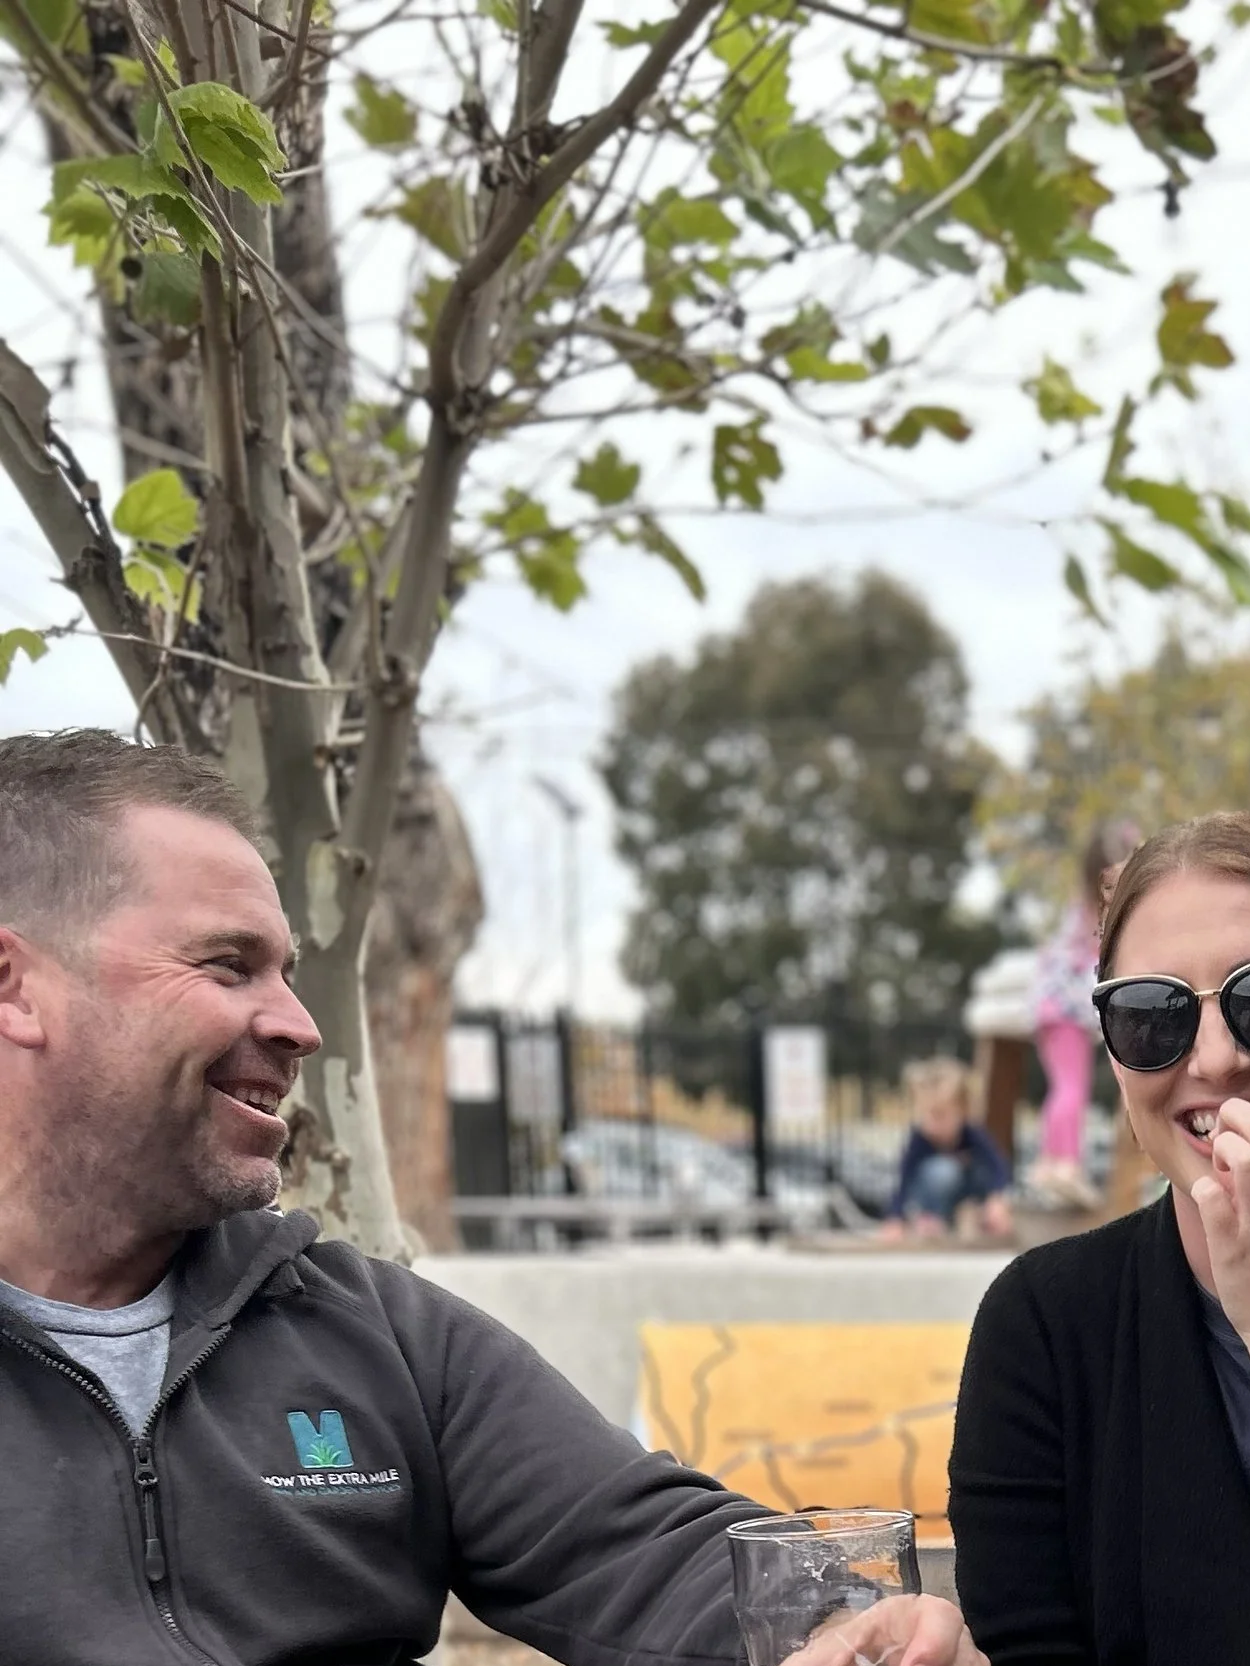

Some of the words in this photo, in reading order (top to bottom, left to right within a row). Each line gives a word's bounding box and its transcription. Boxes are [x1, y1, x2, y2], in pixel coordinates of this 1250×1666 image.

[297, 1473, 326, 1486] THE
[327, 1472, 369, 1485] EXTRA
[369, 1468, 399, 1483] MILE
